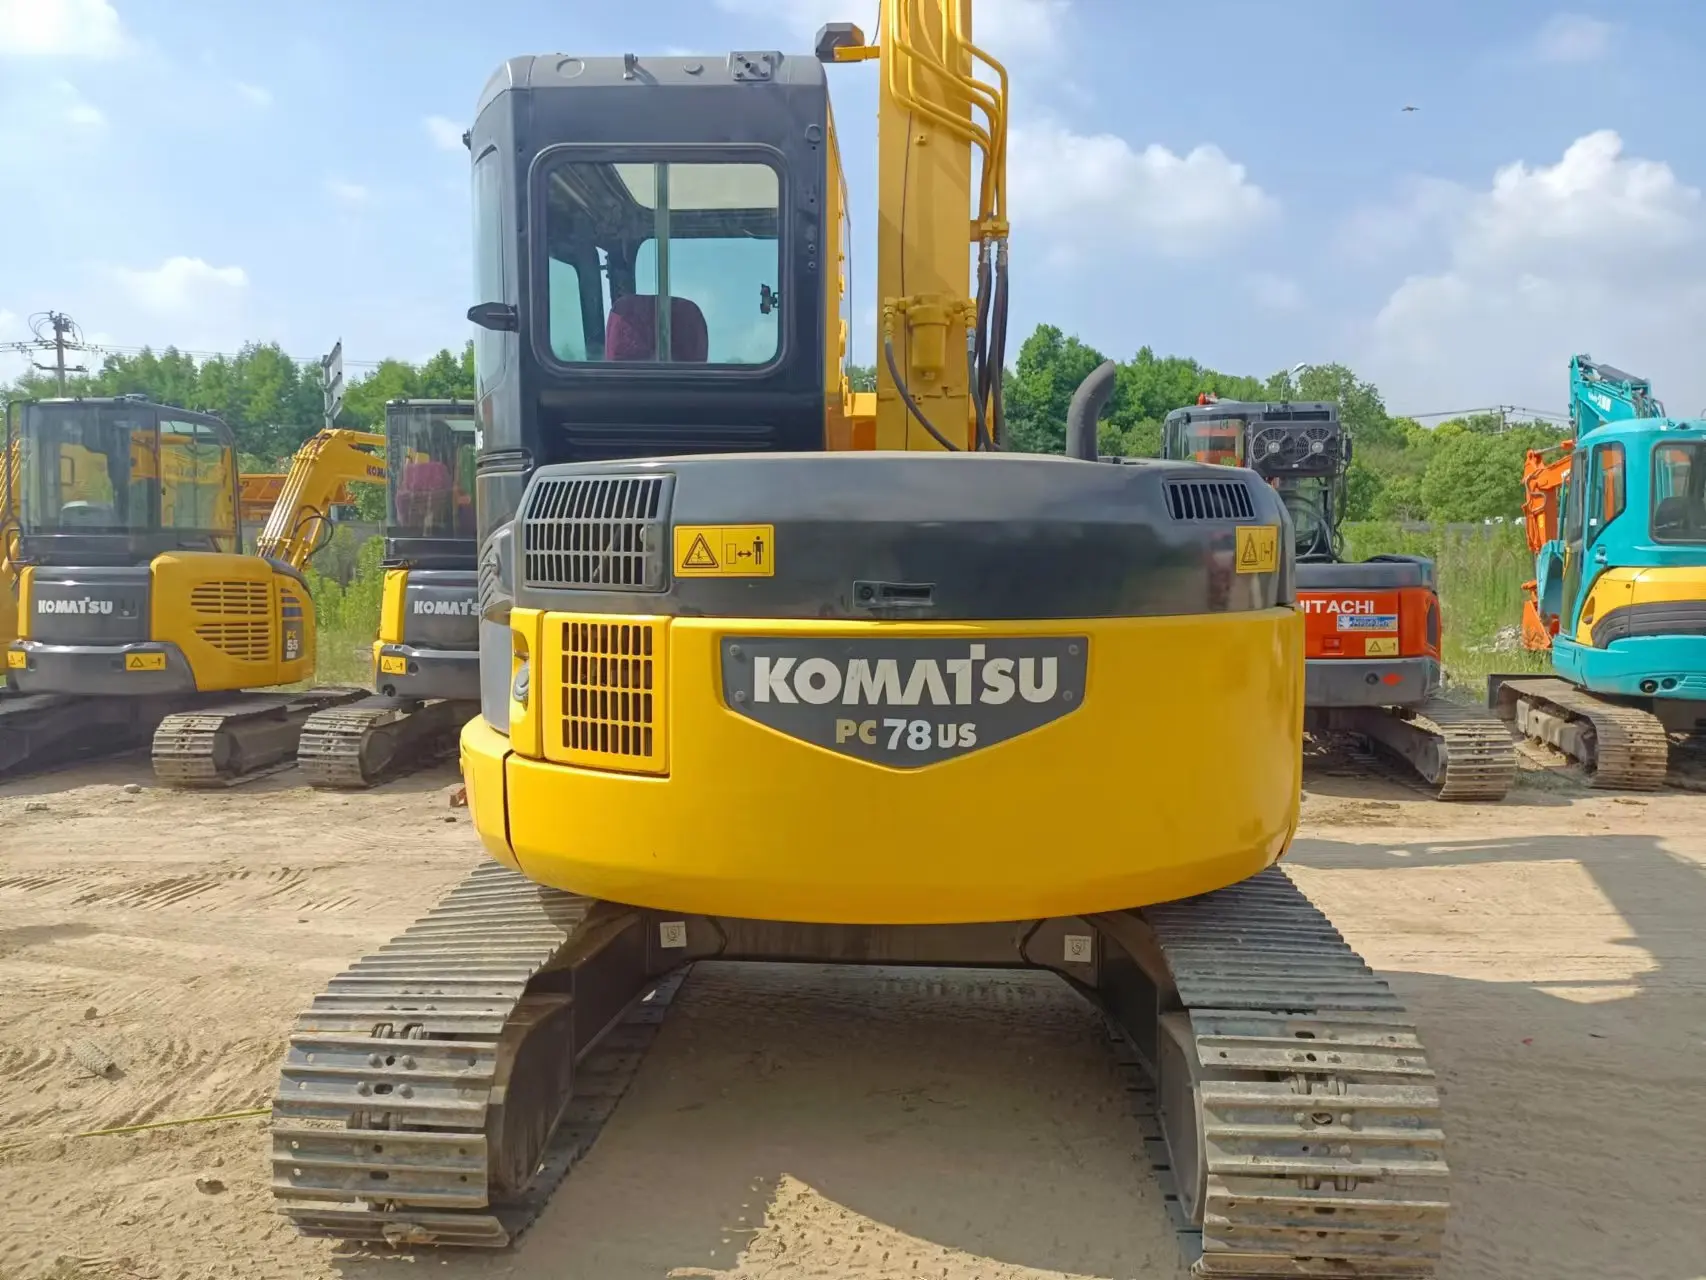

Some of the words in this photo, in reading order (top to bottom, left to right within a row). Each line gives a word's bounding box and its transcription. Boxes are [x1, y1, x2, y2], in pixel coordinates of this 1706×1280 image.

[37, 597, 113, 614] KOMATSU
[413, 598, 480, 615] KOMATS
[754, 643, 1058, 705] KOMATSU
[835, 719, 877, 744] PC
[883, 718, 932, 750] 78
[938, 722, 977, 748] US
